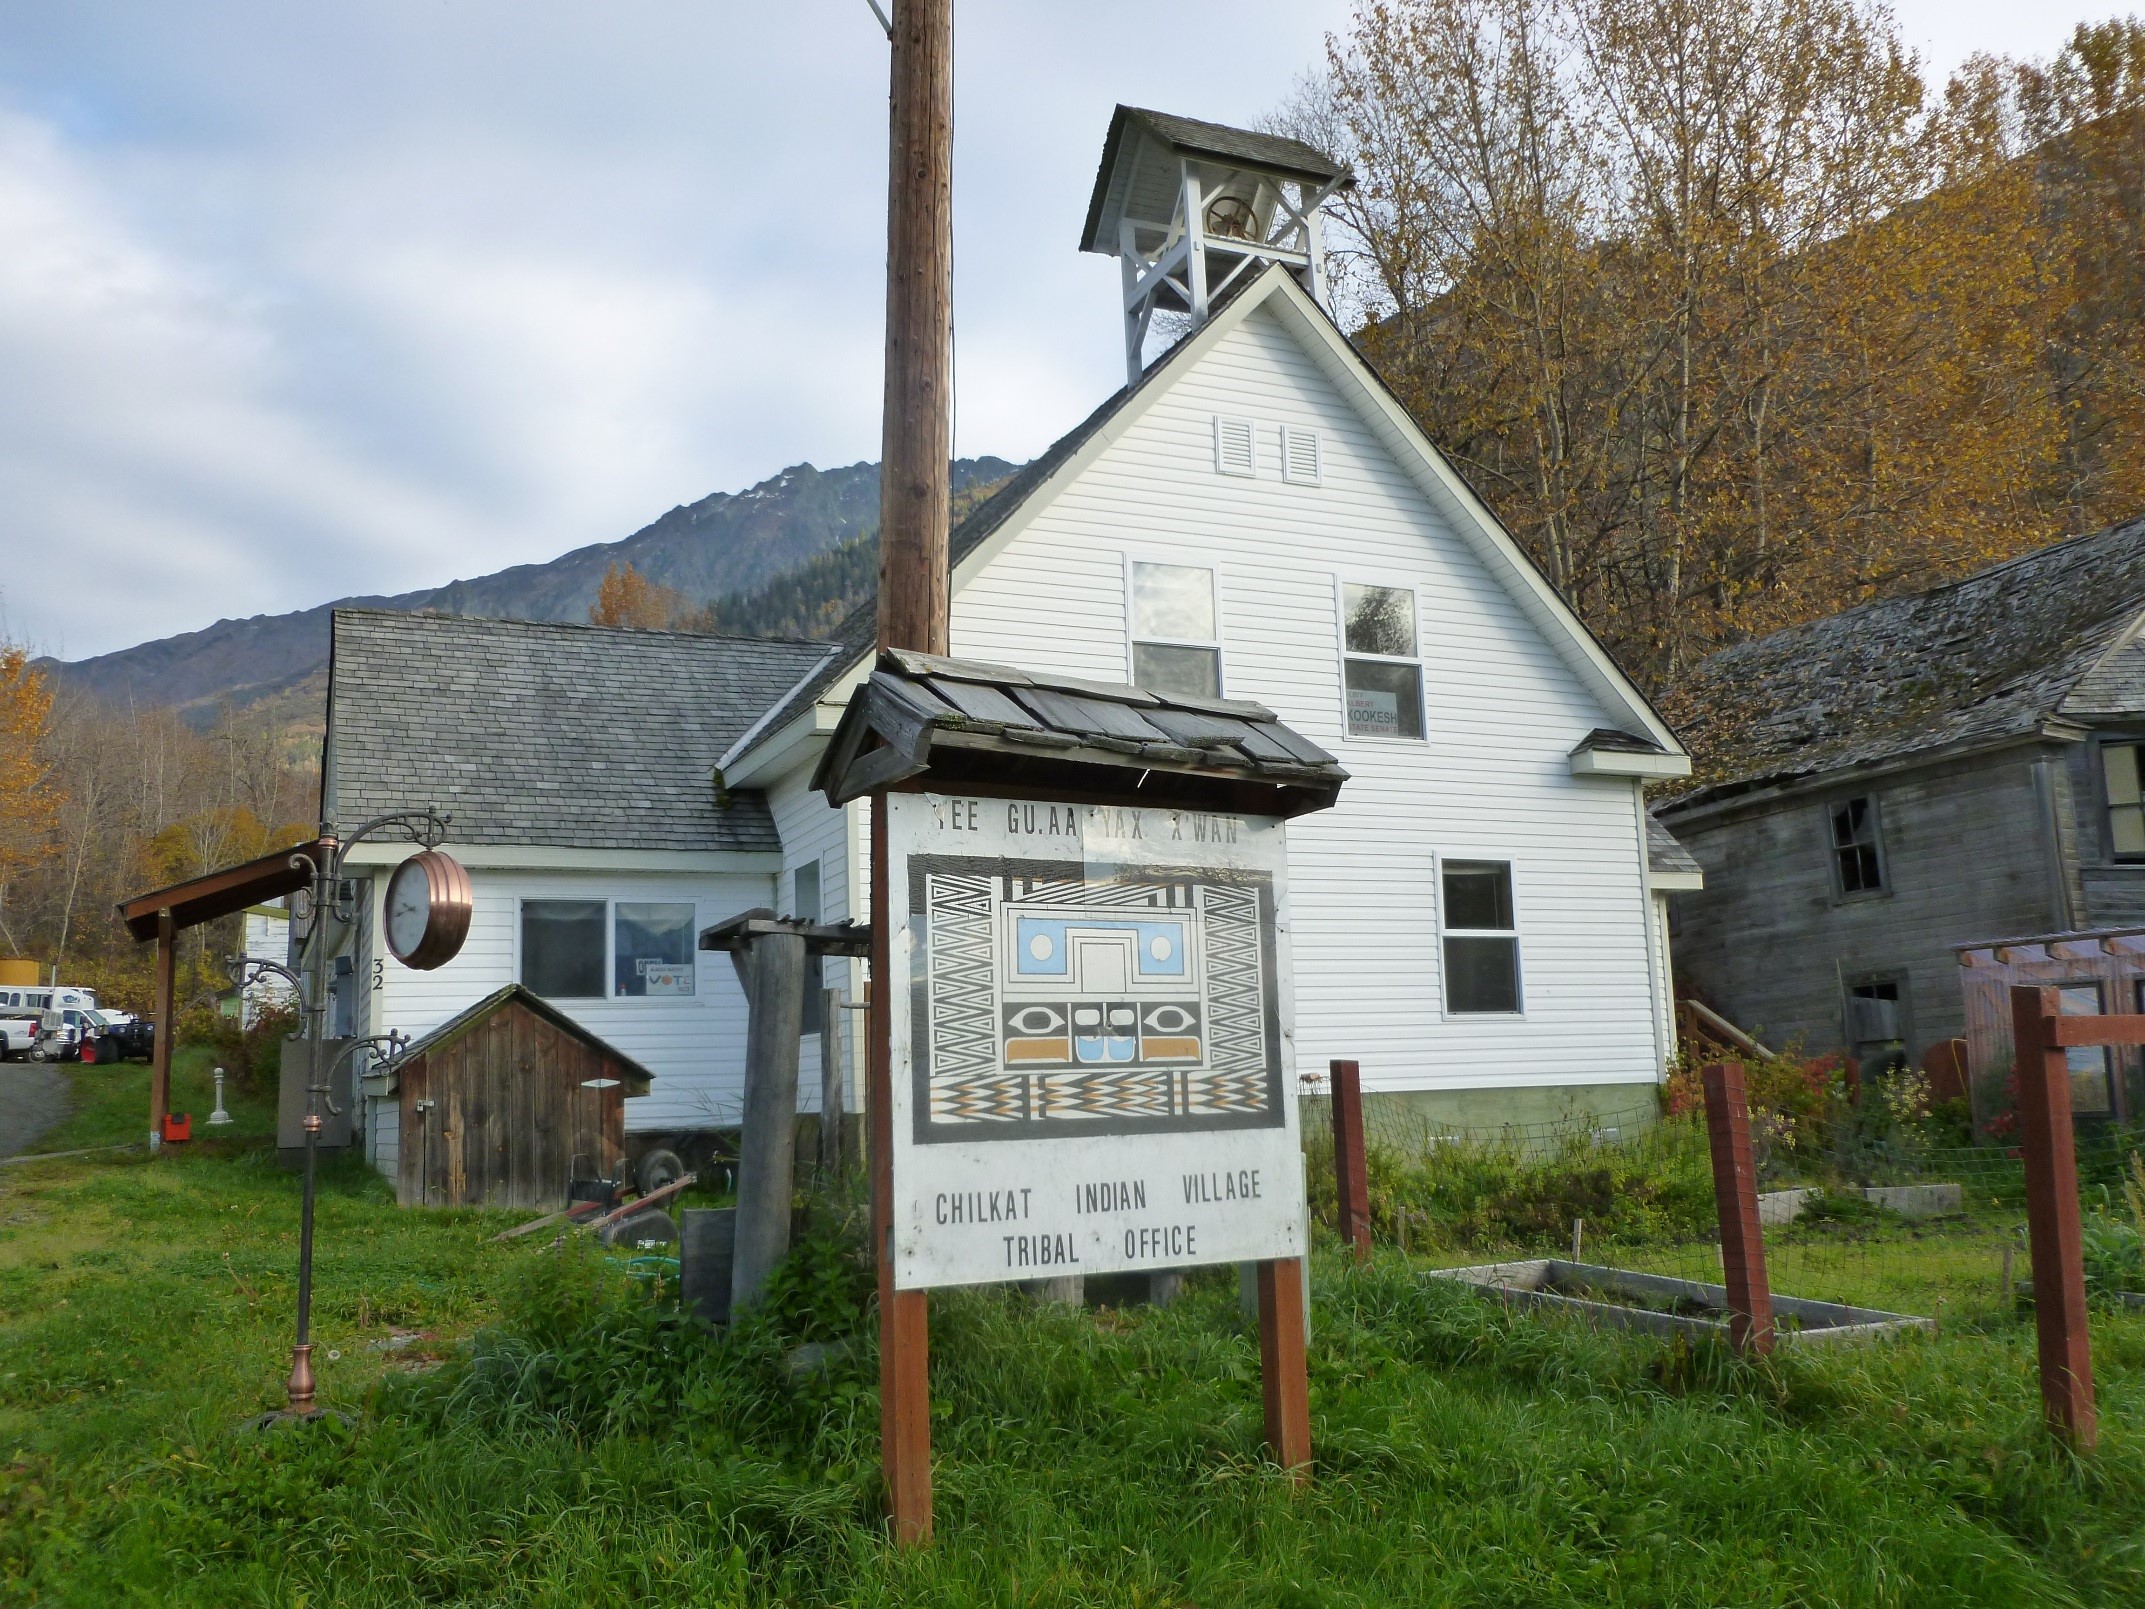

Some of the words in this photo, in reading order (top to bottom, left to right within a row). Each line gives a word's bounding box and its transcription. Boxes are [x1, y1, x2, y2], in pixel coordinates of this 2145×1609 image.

[1347, 700, 1374, 708] ALBERT
[1348, 709, 1397, 724] KOOKESH
[1348, 724, 1369, 732] STATE
[1371, 725, 1398, 734] SENATE
[1103, 808, 1143, 840] YAX
[935, 1188, 1032, 1224] CHILKAT
[1076, 1179, 1147, 1214] INDIAN
[1182, 1169, 1262, 1204] VILLAGE
[1003, 1232, 1080, 1267] TRIBAL
[1124, 1225, 1197, 1259] OFFICE
